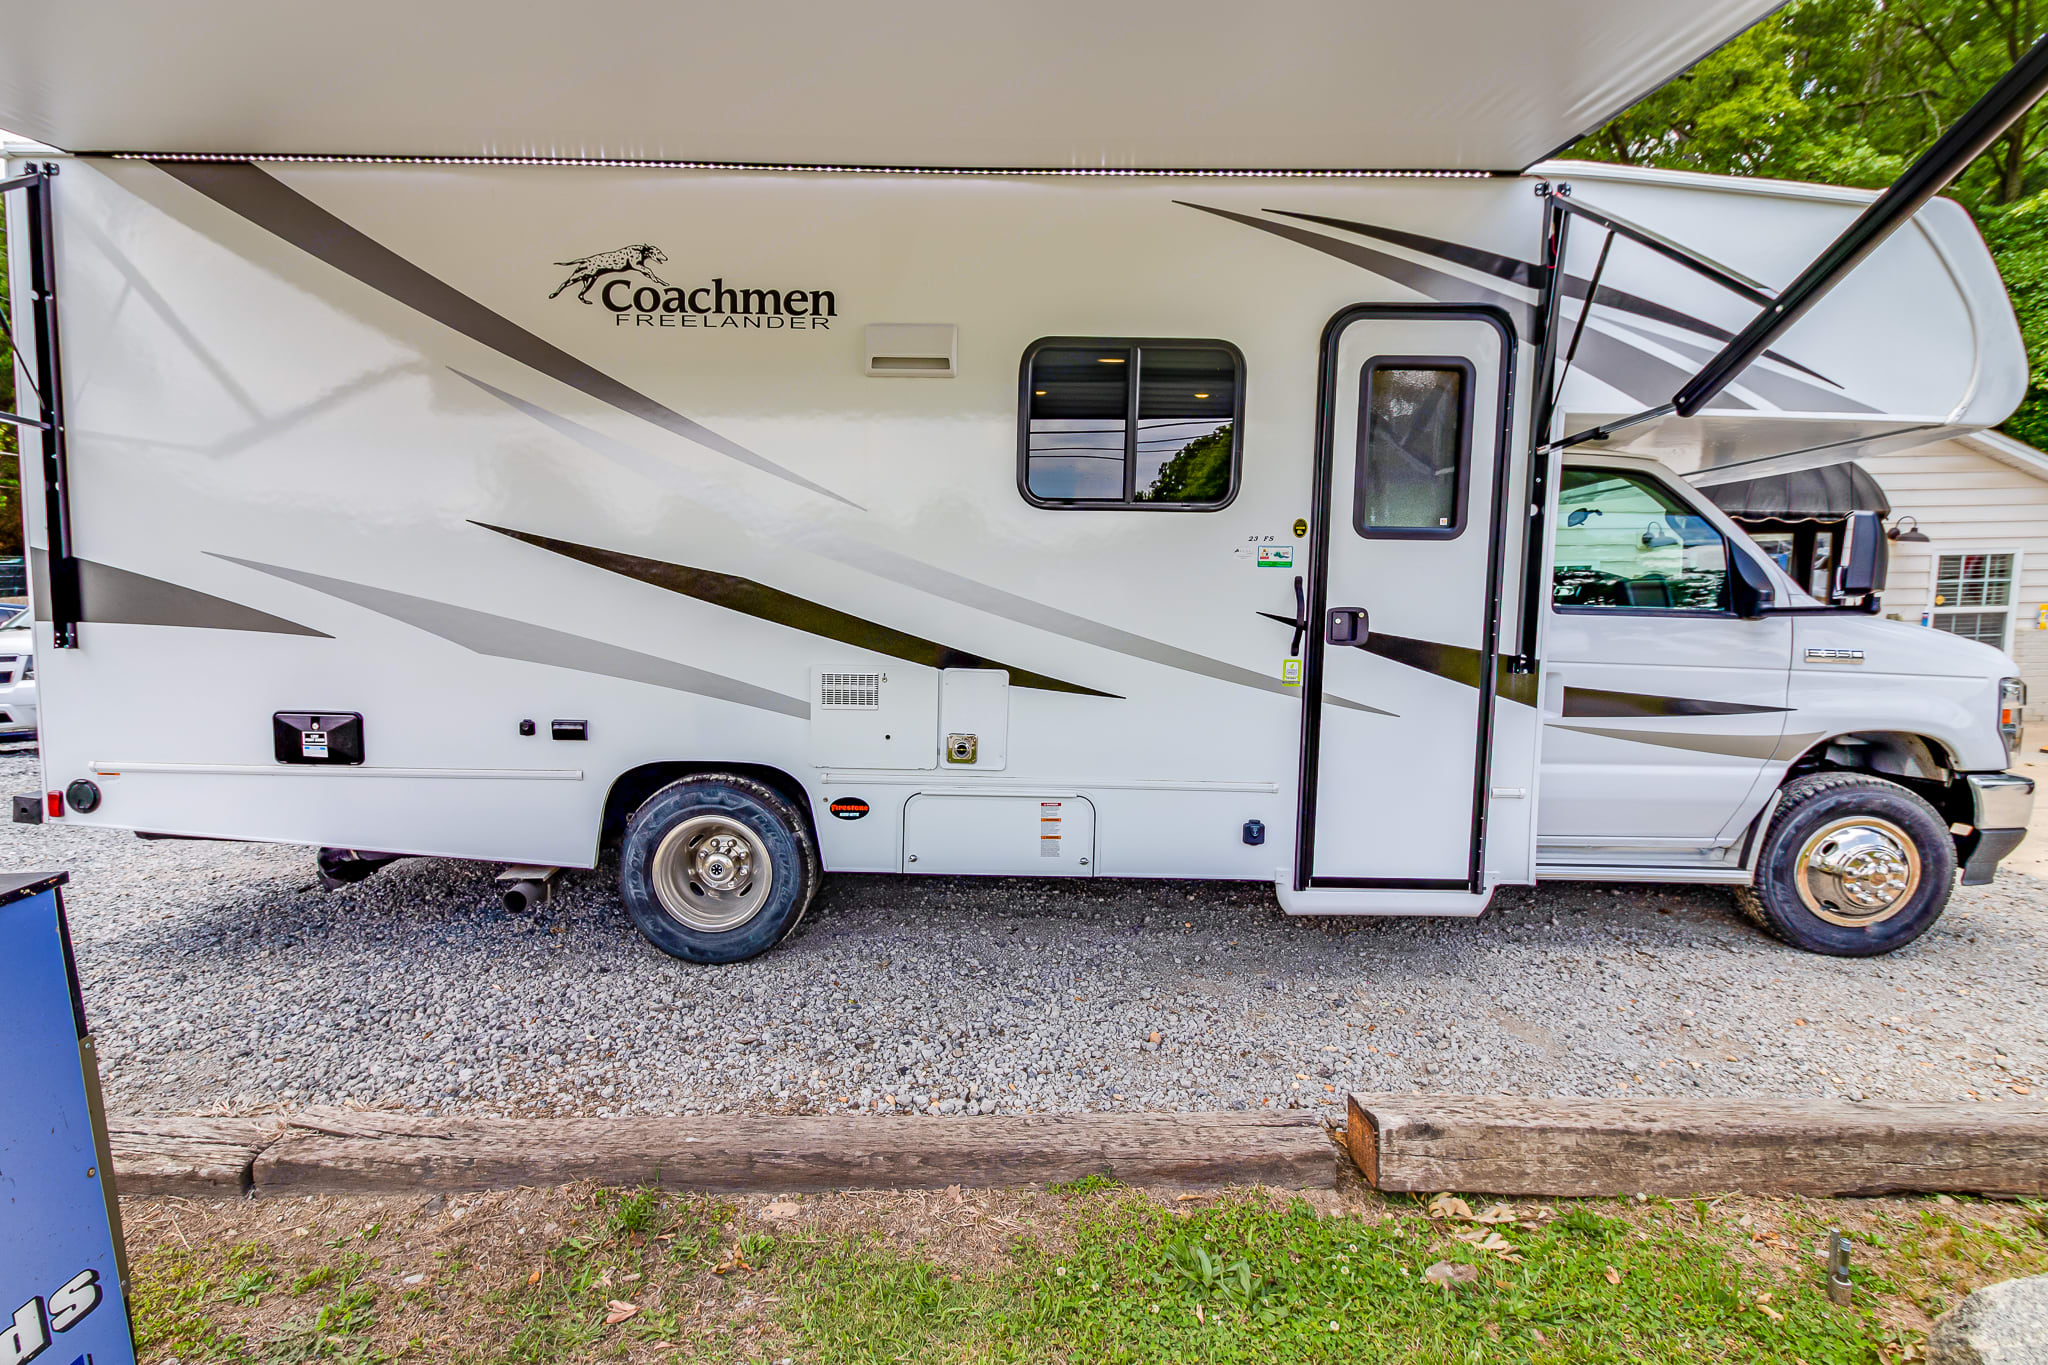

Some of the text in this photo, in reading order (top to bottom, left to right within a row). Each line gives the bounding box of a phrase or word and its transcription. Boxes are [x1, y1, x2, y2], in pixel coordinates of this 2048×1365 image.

[601, 278, 838, 317] Coachmen
[615, 313, 831, 330] FREELANDER
[830, 803, 869, 812] Firestone
